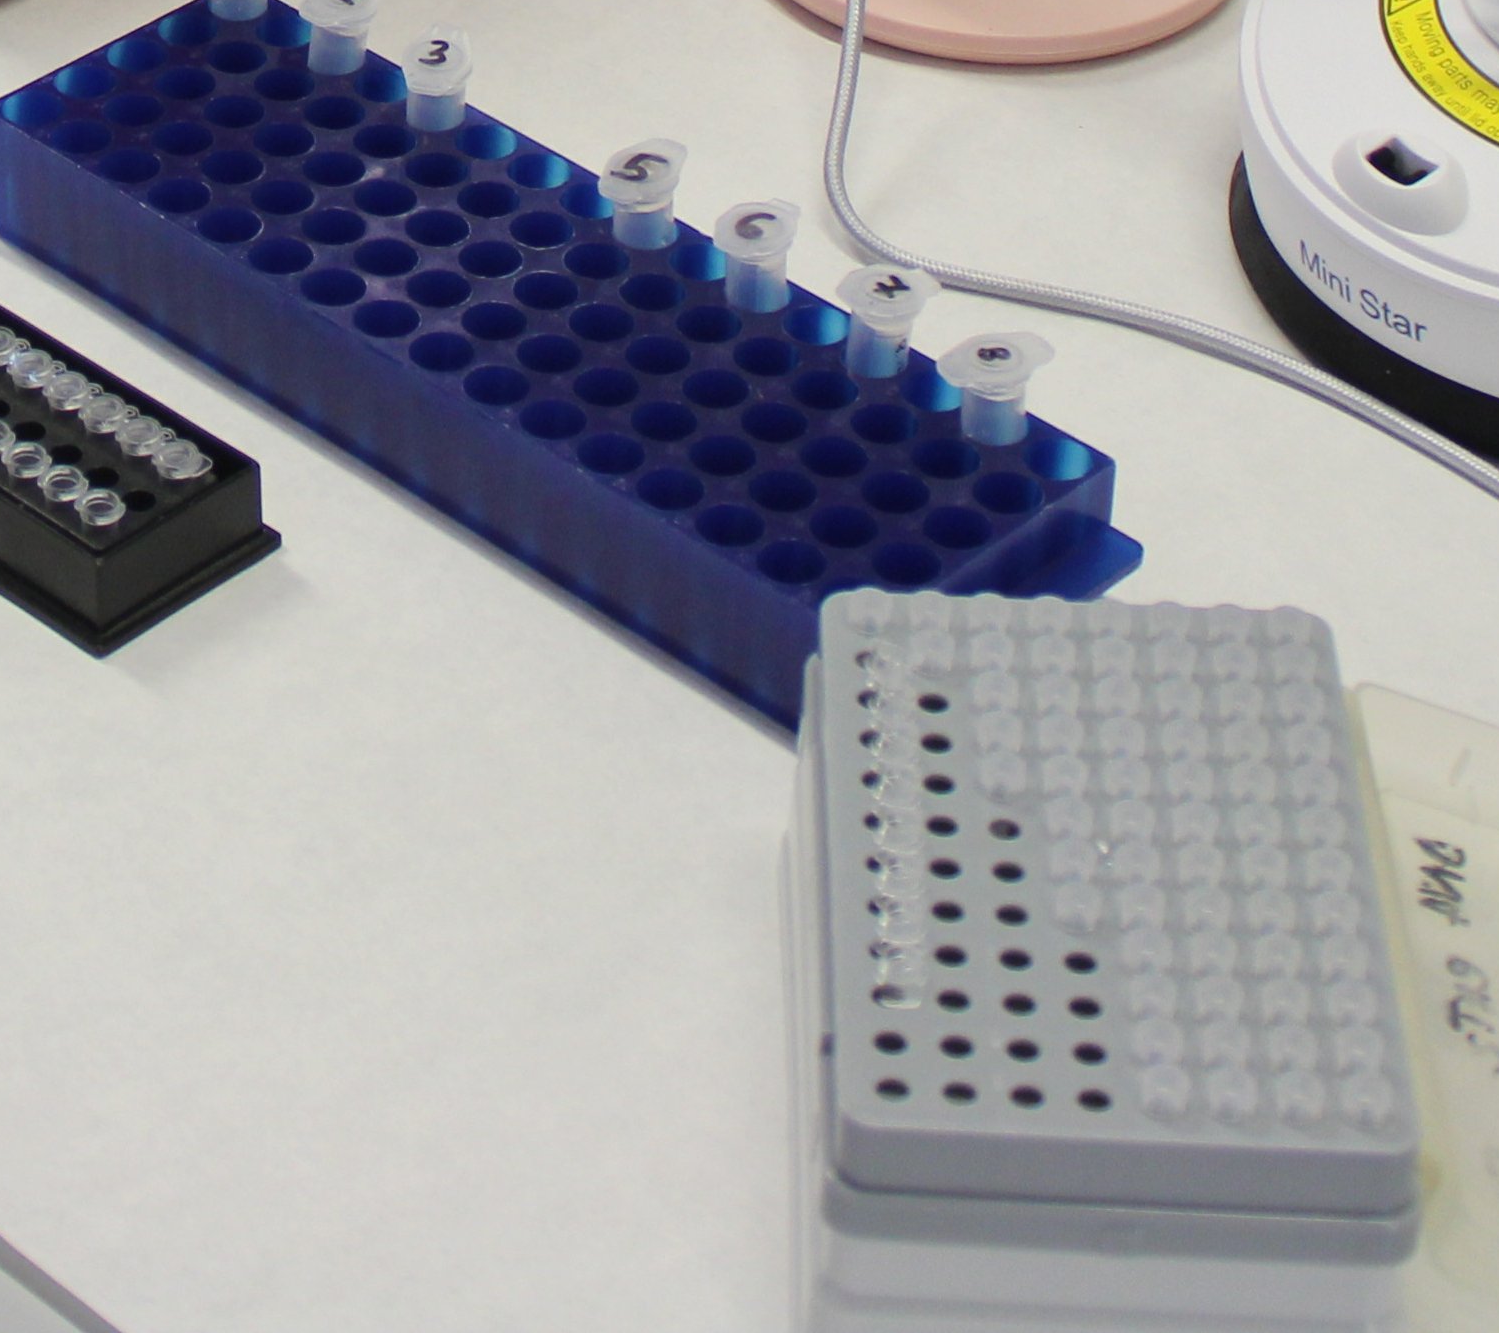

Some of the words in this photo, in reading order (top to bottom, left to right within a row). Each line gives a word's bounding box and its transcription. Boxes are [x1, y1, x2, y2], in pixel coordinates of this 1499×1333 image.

[417, 39, 450, 66] 3
[1415, 10, 1445, 58] Moving
[1438, 57, 1473, 91] parts
[609, 152, 670, 182] 5
[734, 211, 778, 240] 6
[1300, 238, 1352, 304] Mini
[1358, 287, 1427, 343] Star
